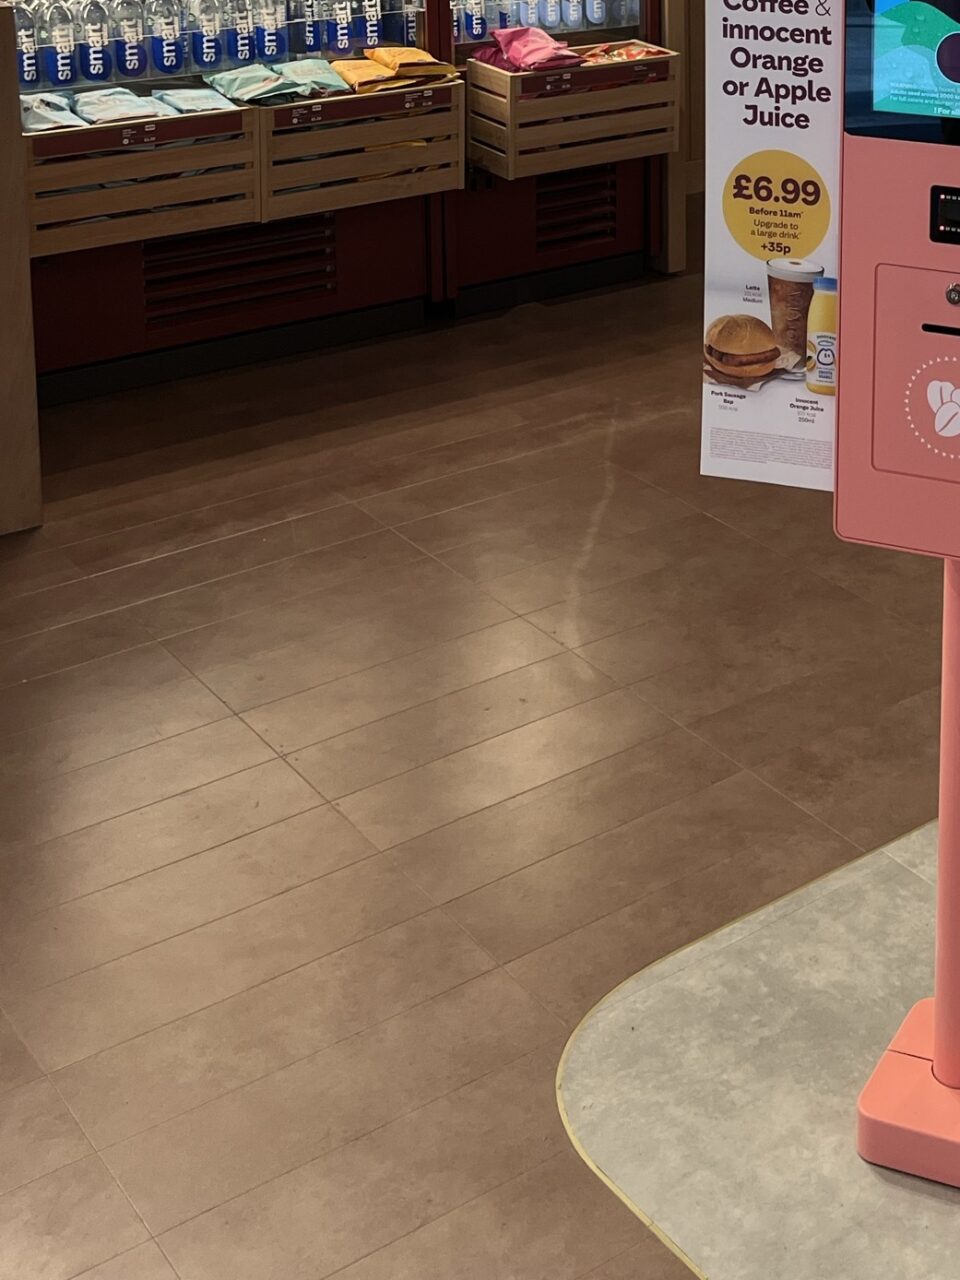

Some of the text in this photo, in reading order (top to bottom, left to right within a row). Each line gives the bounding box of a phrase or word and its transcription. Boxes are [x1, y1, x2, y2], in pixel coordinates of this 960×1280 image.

[234, 10, 250, 60] smart
[261, 7, 277, 56] smart
[335, 1, 349, 49] smart
[722, 17, 832, 45] innocent
[18, 29, 36, 81] smart
[52, 25, 71, 81] smart
[159, 16, 177, 66] smart
[730, 46, 824, 77] Orange
[722, 77, 832, 105] or Apple
[743, 104, 810, 129] Juice
[732, 174, 821, 206] £6.99
[749, 207, 778, 217] Before
[753, 219, 799, 230] Upgrade to
[756, 229, 777, 239] large
[761, 242, 791, 255] +35p
